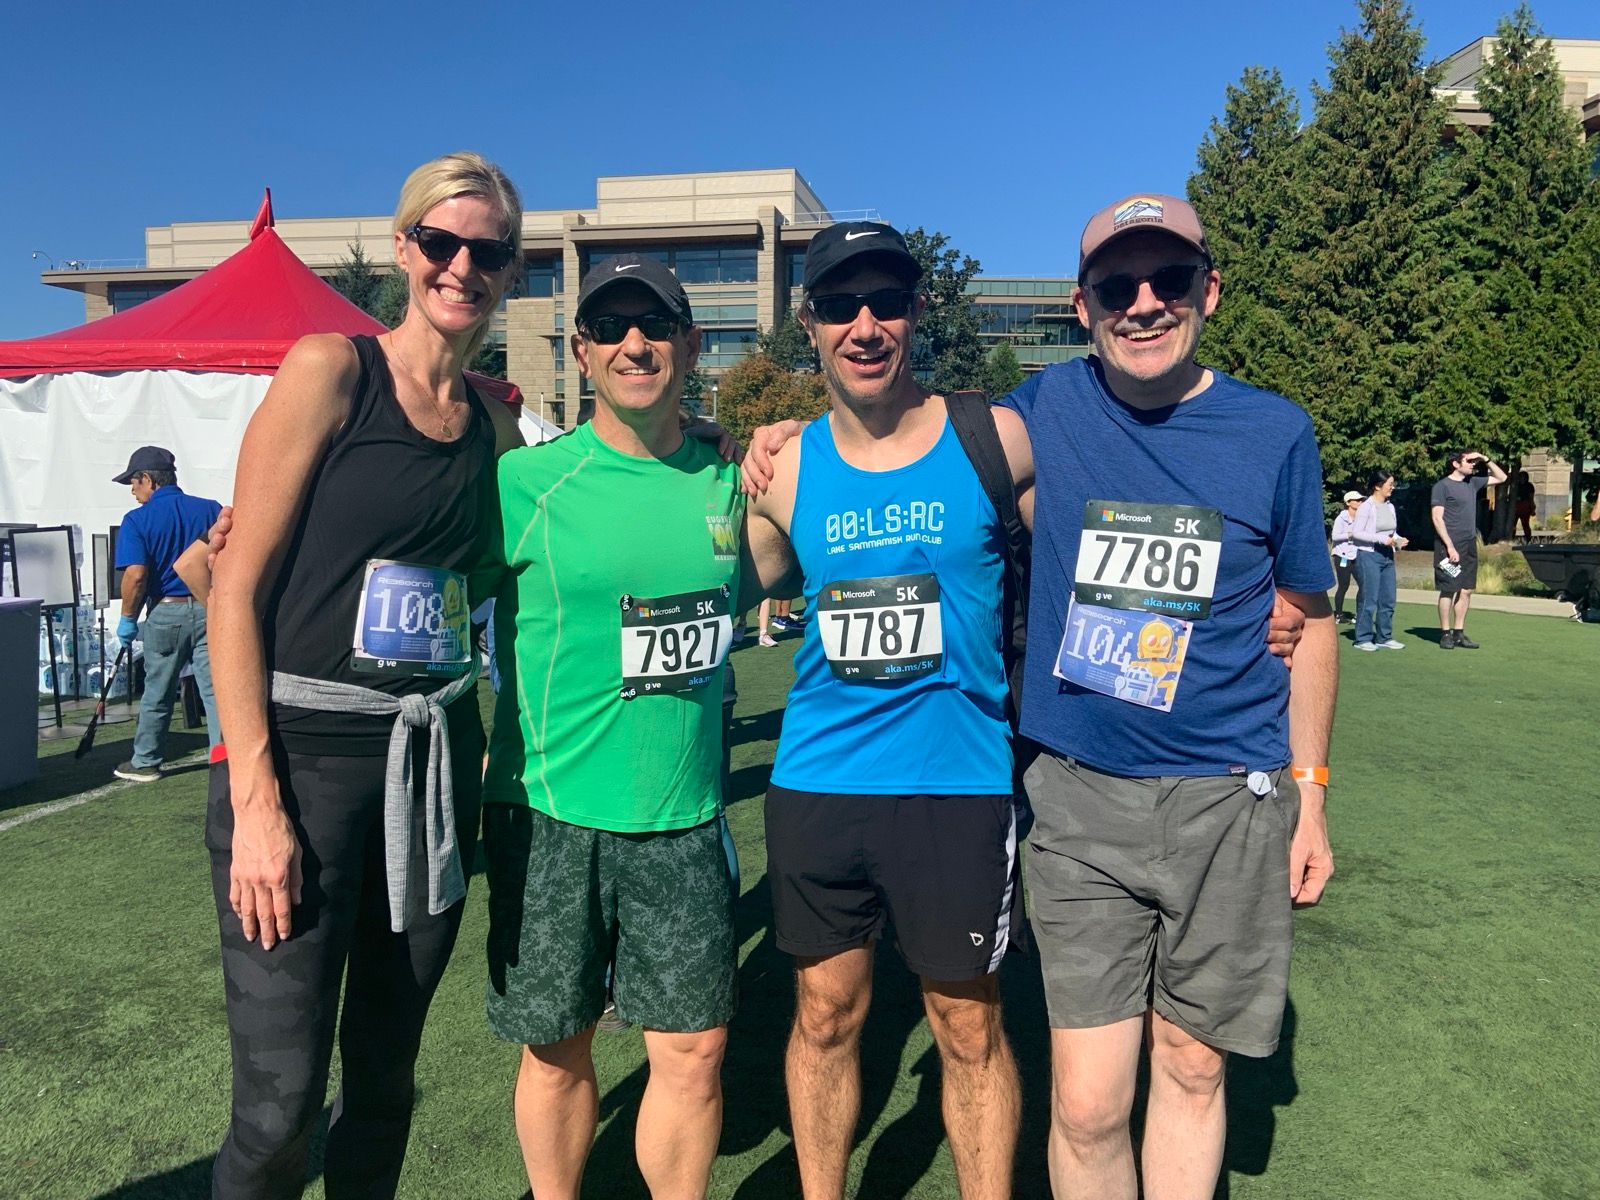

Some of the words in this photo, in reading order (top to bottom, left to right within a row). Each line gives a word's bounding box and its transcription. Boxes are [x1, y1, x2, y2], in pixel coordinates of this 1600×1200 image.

[1113, 218, 1164, 231] patagonia
[1115, 513, 1152, 524] Microsoft
[1174, 517, 1201, 536] 5K
[826, 544, 846, 555] LAKE
[848, 536, 903, 552] SAMMAMISH
[905, 532, 922, 543] RUN
[921, 534, 942, 545] CLUB
[1093, 534, 1202, 592] 7786
[842, 589, 876, 599] Microsoft
[896, 586, 919, 602] 5K
[1095, 591, 1113, 601] gve
[1143, 596, 1201, 612] aka.ms/5K
[369, 589, 445, 635] 108
[650, 605, 681, 617] Microsoft
[696, 600, 715, 616] 5K
[831, 607, 925, 657] 7787
[636, 620, 720, 674] 7927
[1066, 617, 1134, 673] 104
[377, 659, 397, 668] gve
[845, 667, 860, 675] gve
[885, 660, 934, 674] aka.ms/5K
[645, 682, 661, 691] gve
